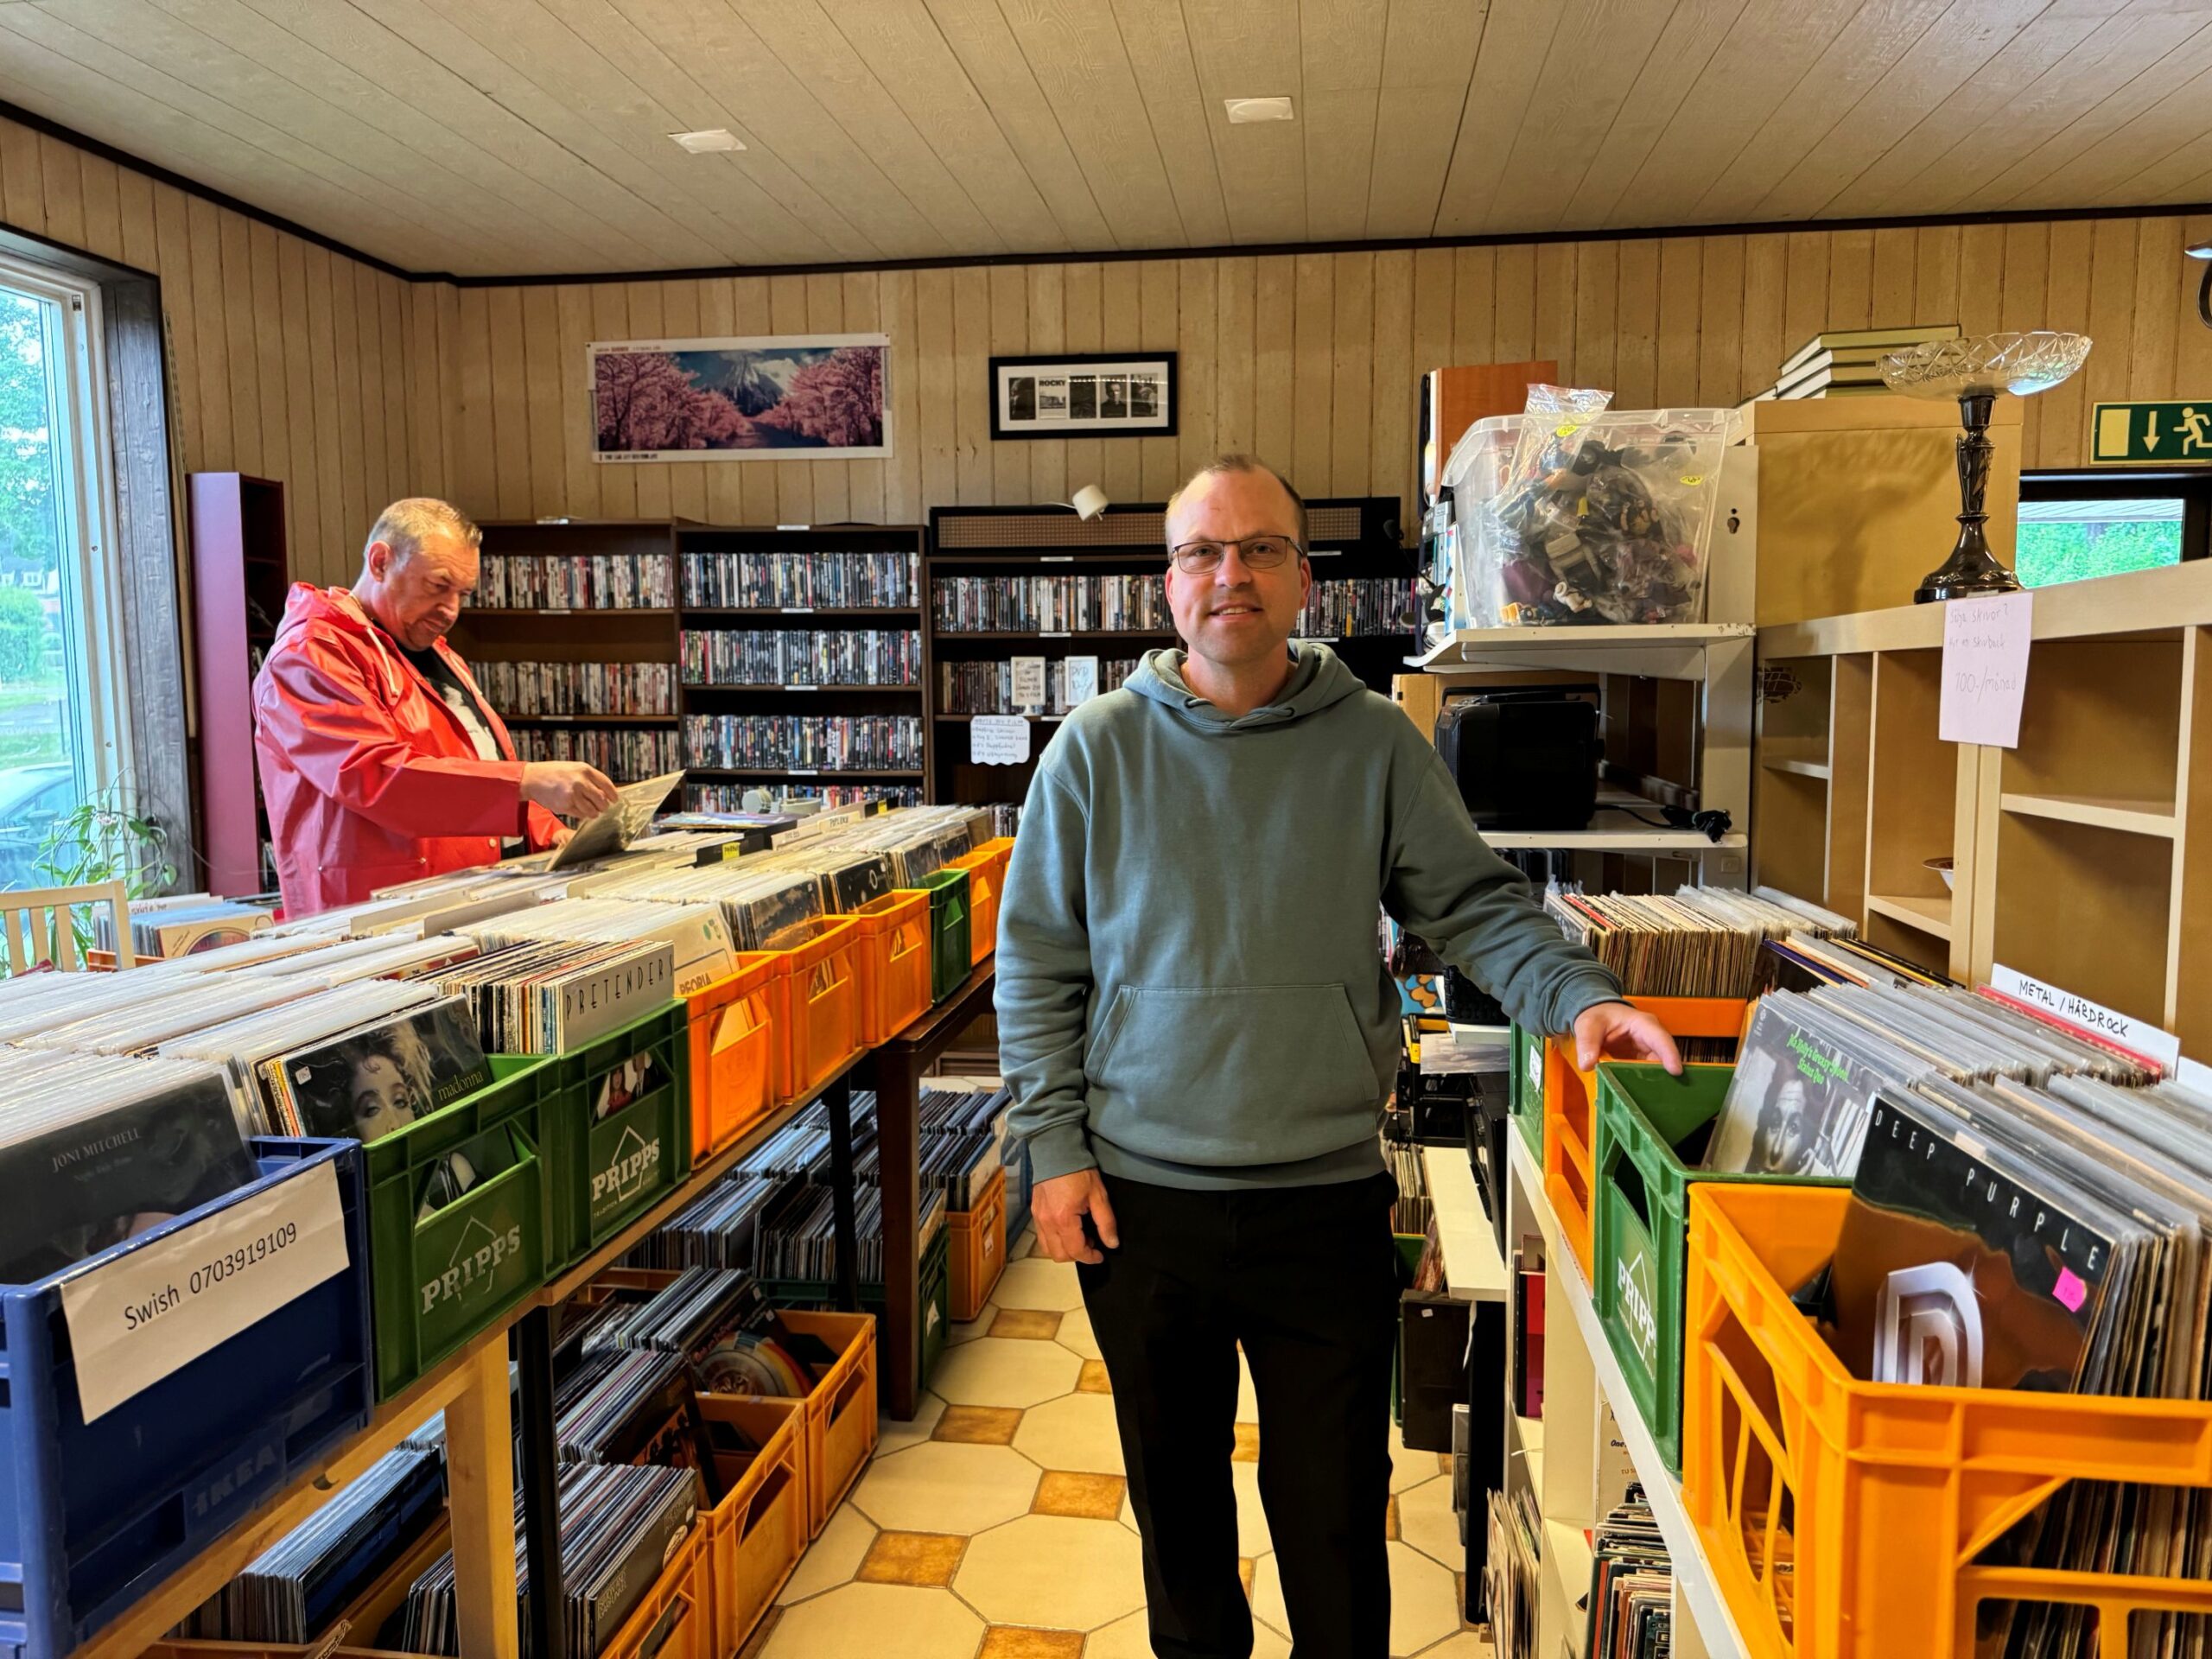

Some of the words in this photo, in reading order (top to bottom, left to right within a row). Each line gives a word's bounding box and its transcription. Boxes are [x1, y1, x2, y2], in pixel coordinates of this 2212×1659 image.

[566, 953, 673, 1021] PRETENDERS
[2018, 979, 2055, 1007] METAL
[437, 1071, 484, 1102] madonna
[51, 1147, 82, 1173] JONI
[82, 1127, 142, 1159] MITCHELL
[591, 1136, 660, 1203] PRIPPS
[1874, 1109, 1936, 1160] DEEP
[1965, 1167, 2100, 1271] PURPLE
[124, 1283, 181, 1331] Swish
[189, 1222, 297, 1294] 0703919109
[420, 1224, 521, 1316] PRIPPS
[1617, 1255, 1657, 1359] PRIPP
[192, 1442, 278, 1518] IKEA
